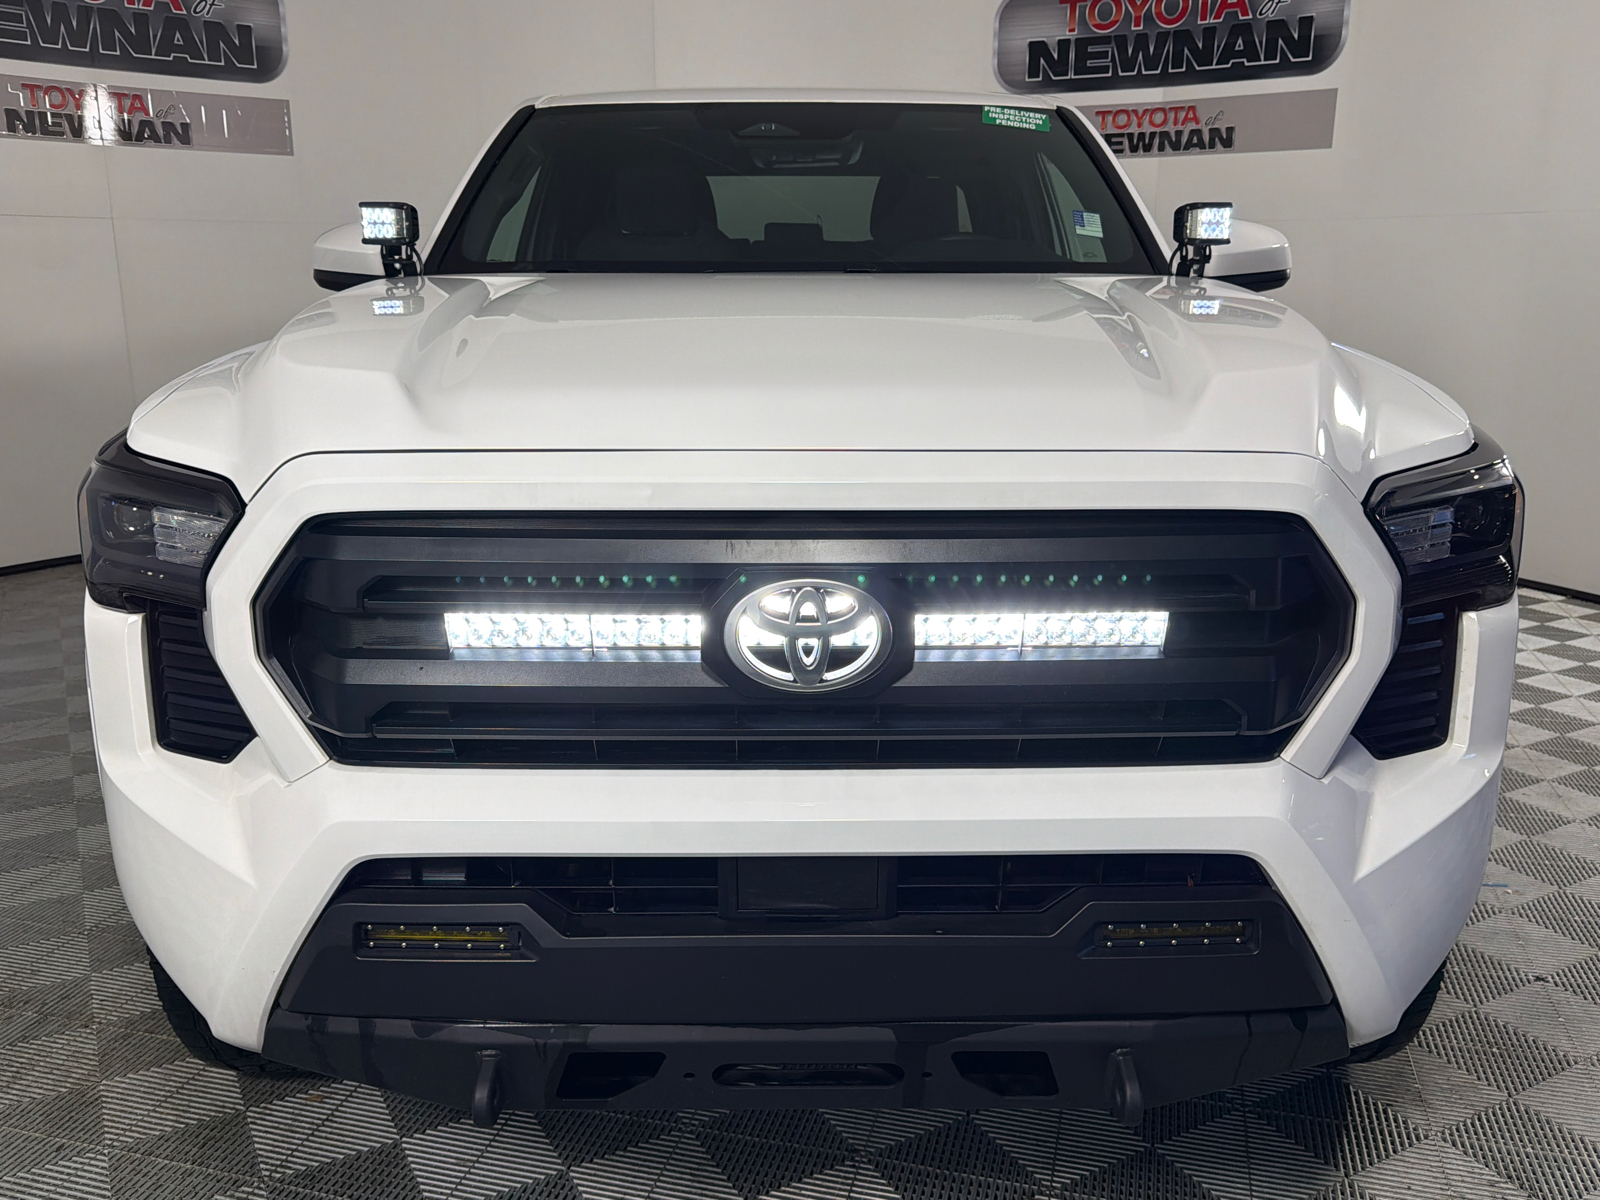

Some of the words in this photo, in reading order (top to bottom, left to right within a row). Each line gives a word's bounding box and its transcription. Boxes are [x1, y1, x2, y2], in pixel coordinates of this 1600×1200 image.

[0, 0, 257, 68] EWNAN
[1025, 15, 1315, 82] NEWNAN
[21, 83, 150, 117] TOYTA
[155, 104, 175, 120] of
[984, 106, 1046, 120] PRE-DELIVERY
[989, 112, 1042, 125] INSPECTION
[996, 118, 1036, 130] PENDING
[1095, 105, 1200, 131] TOYOTA
[1204, 109, 1224, 126] of
[1101, 126, 1235, 154] EWNAN
